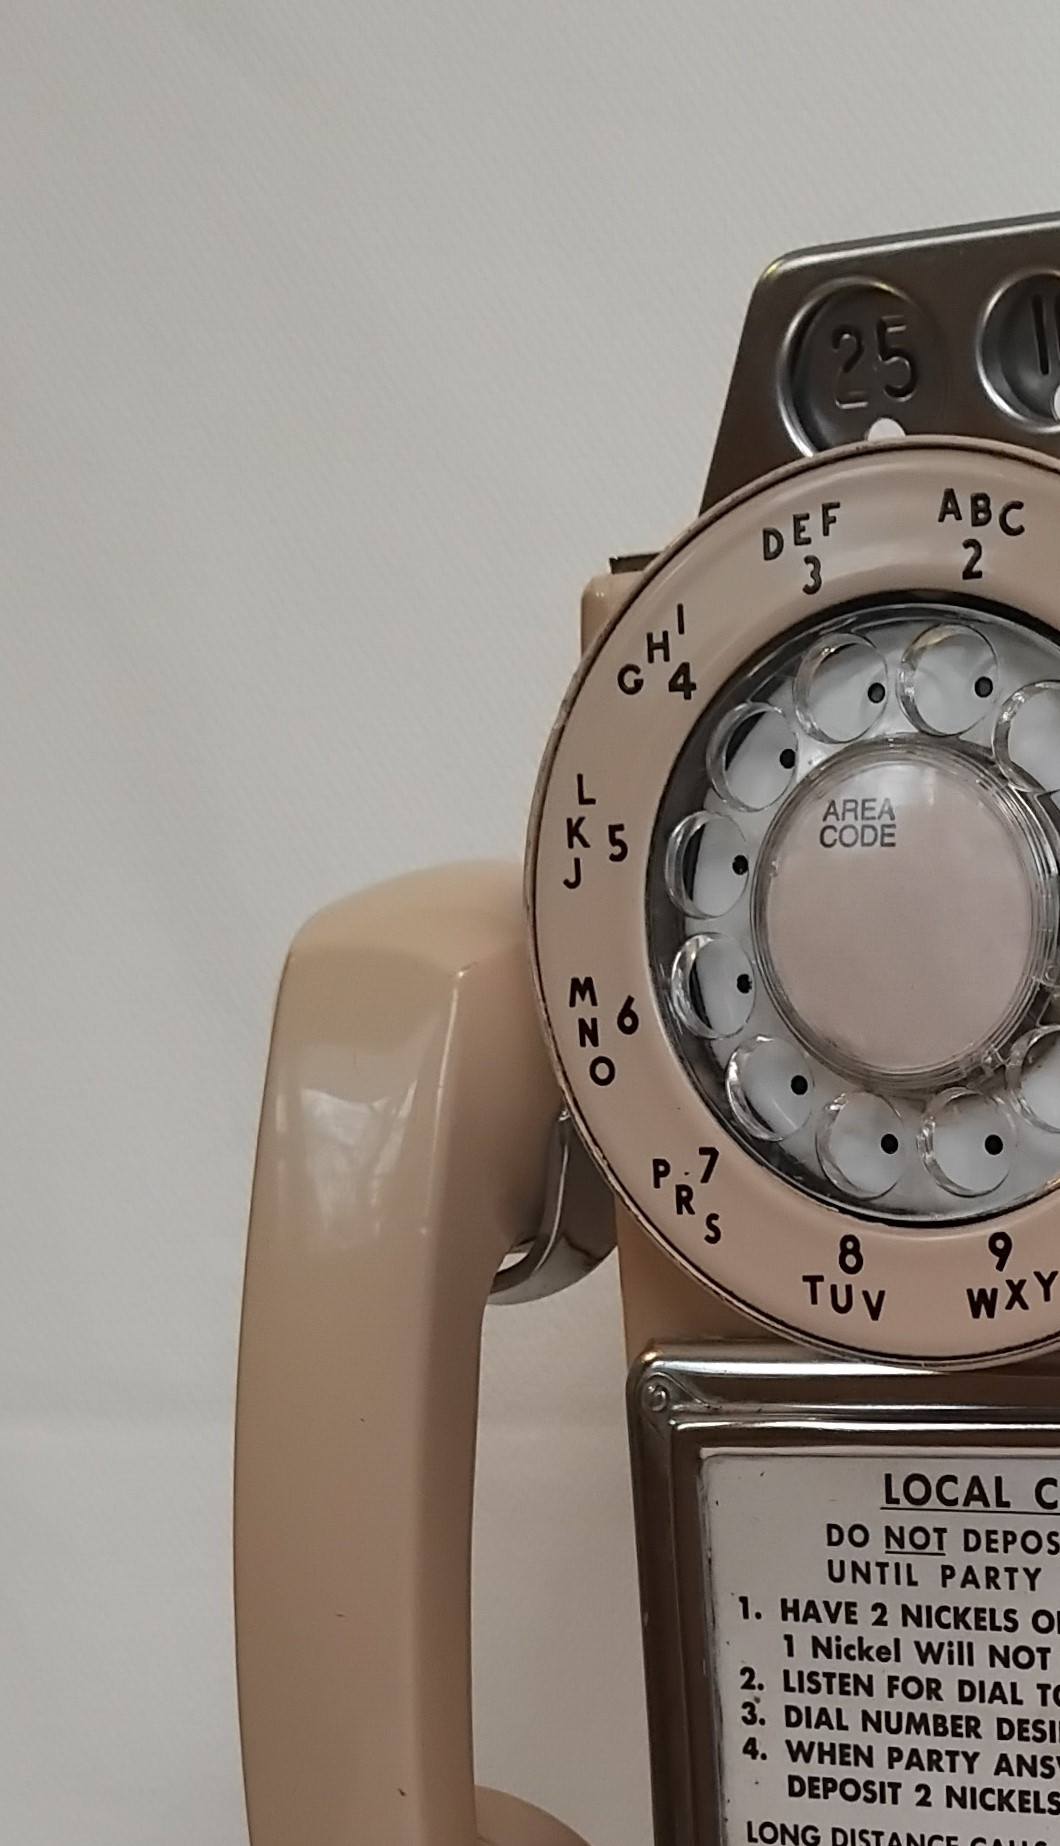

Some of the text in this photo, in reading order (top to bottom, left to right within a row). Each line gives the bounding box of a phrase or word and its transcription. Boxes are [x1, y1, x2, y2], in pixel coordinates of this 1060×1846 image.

[831, 315, 918, 410] 25
[763, 502, 840, 560] DEF
[938, 488, 1024, 536] ABC
[803, 556, 821, 595] 3
[962, 539, 982, 580] 2
[669, 662, 697, 700] 4
[822, 798, 896, 821] AREA
[607, 824, 629, 862] 5
[820, 823, 897, 848] CODE
[617, 995, 640, 1035] 6
[699, 1146, 720, 1184] 7
[839, 1235, 864, 1274] 8
[988, 1232, 1012, 1271] 9
[802, 1275, 886, 1321] TUV
[967, 1271, 1059, 1319] WXY
[884, 1473, 1011, 1508] LOCAL
[826, 1523, 870, 1548] DO
[884, 1525, 948, 1551] NOT
[827, 1559, 919, 1587] UNTIL
[940, 1564, 1042, 1591] PARTY
[738, 1596, 762, 1620] 1.
[780, 1598, 858, 1625] HAVE
[871, 1602, 888, 1627] 2
[901, 1604, 1019, 1633] NICKELS
[783, 1634, 794, 1657] 1
[811, 1635, 901, 1663] Nickel
[914, 1640, 974, 1667] Will
[989, 1644, 1051, 1670] NOT
[739, 1666, 764, 1690] 2.
[783, 1669, 874, 1698] LISTEN
[887, 1675, 944, 1701] FOR
[958, 1679, 1024, 1706] DIAL
[741, 1701, 766, 1726] 3.
[784, 1704, 849, 1731] DIAL
[861, 1709, 983, 1739] NUMBER
[742, 1737, 767, 1761] 4.
[785, 1739, 874, 1768] WHEN
[887, 1746, 980, 1774] PARTY
[787, 1775, 902, 1805] DEPOSIT
[914, 1783, 932, 1807] 2
